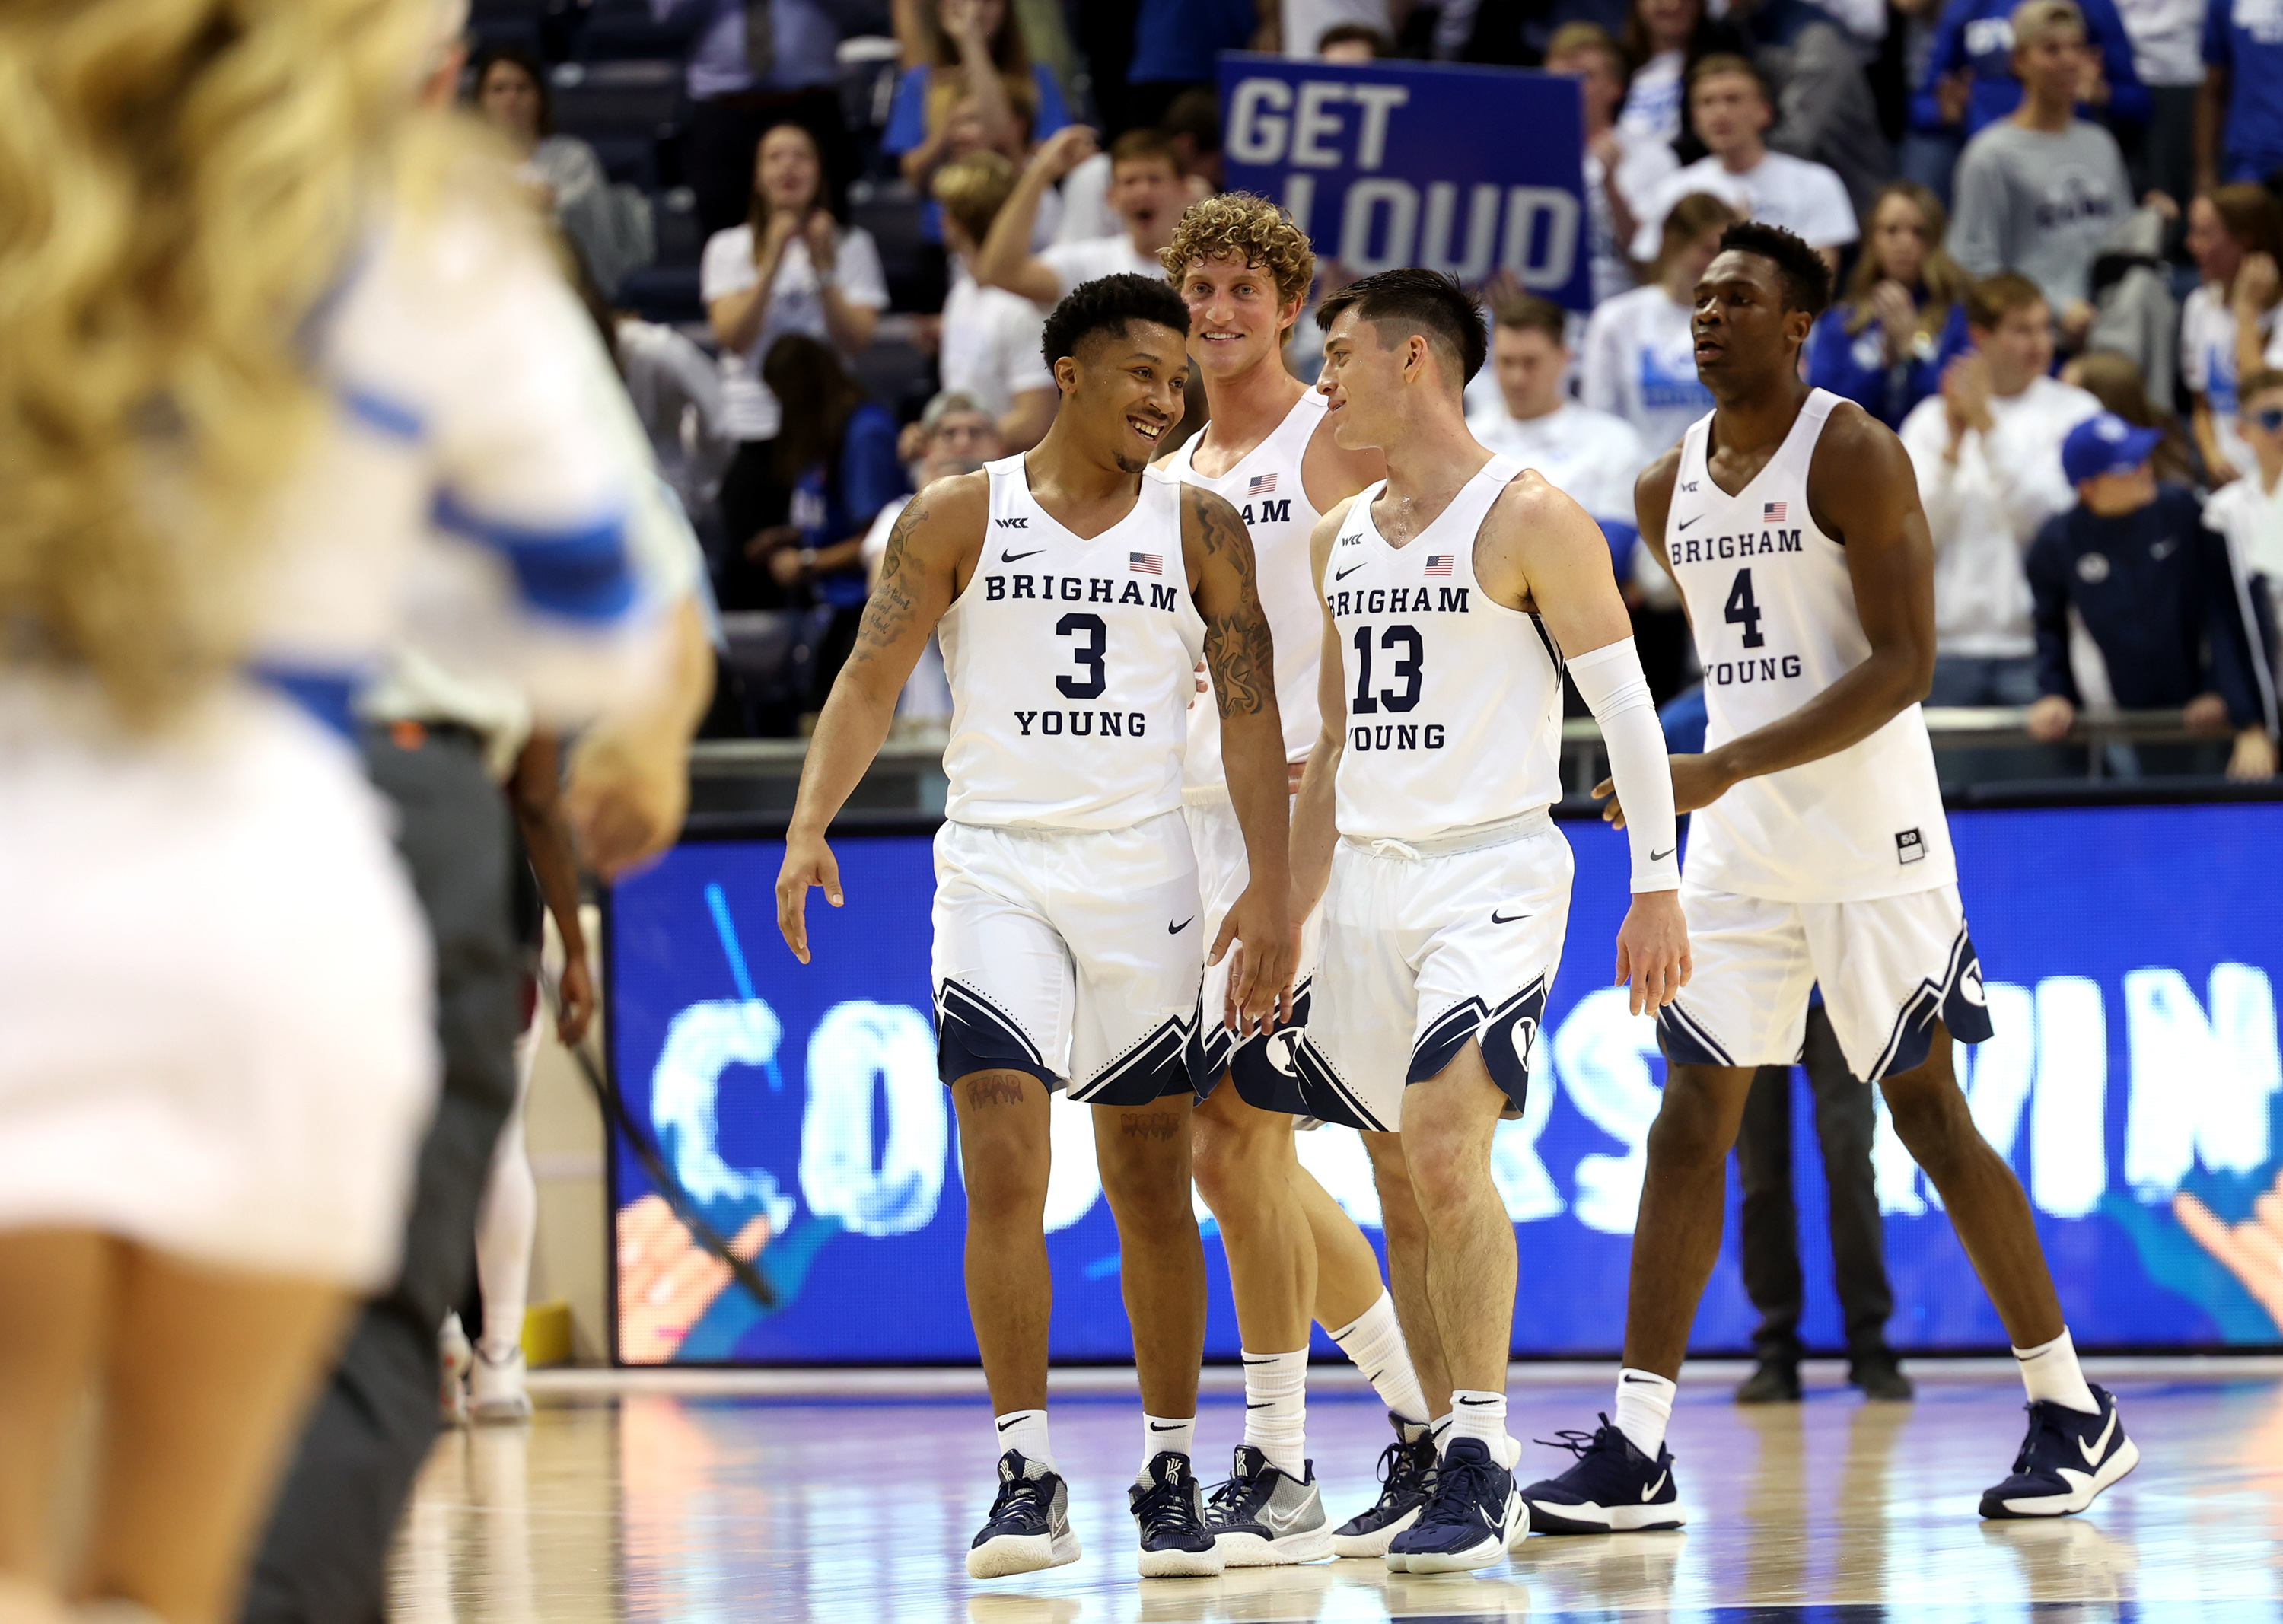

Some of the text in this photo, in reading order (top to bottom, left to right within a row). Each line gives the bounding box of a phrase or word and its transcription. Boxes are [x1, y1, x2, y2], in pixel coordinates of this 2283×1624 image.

[1226, 78, 1409, 169] GET
[995, 517, 1029, 529] WCC
[1342, 533, 1364, 547] WCC
[1672, 530, 1803, 565] BRIGHAM
[985, 574, 1178, 613] BRIGHAM
[1327, 587, 1470, 619] BRIGHAM
[1724, 568, 1765, 648] 4
[1056, 613, 1107, 699] 3
[1352, 625, 1424, 715] 13
[1014, 710, 1145, 737] YOUNG
